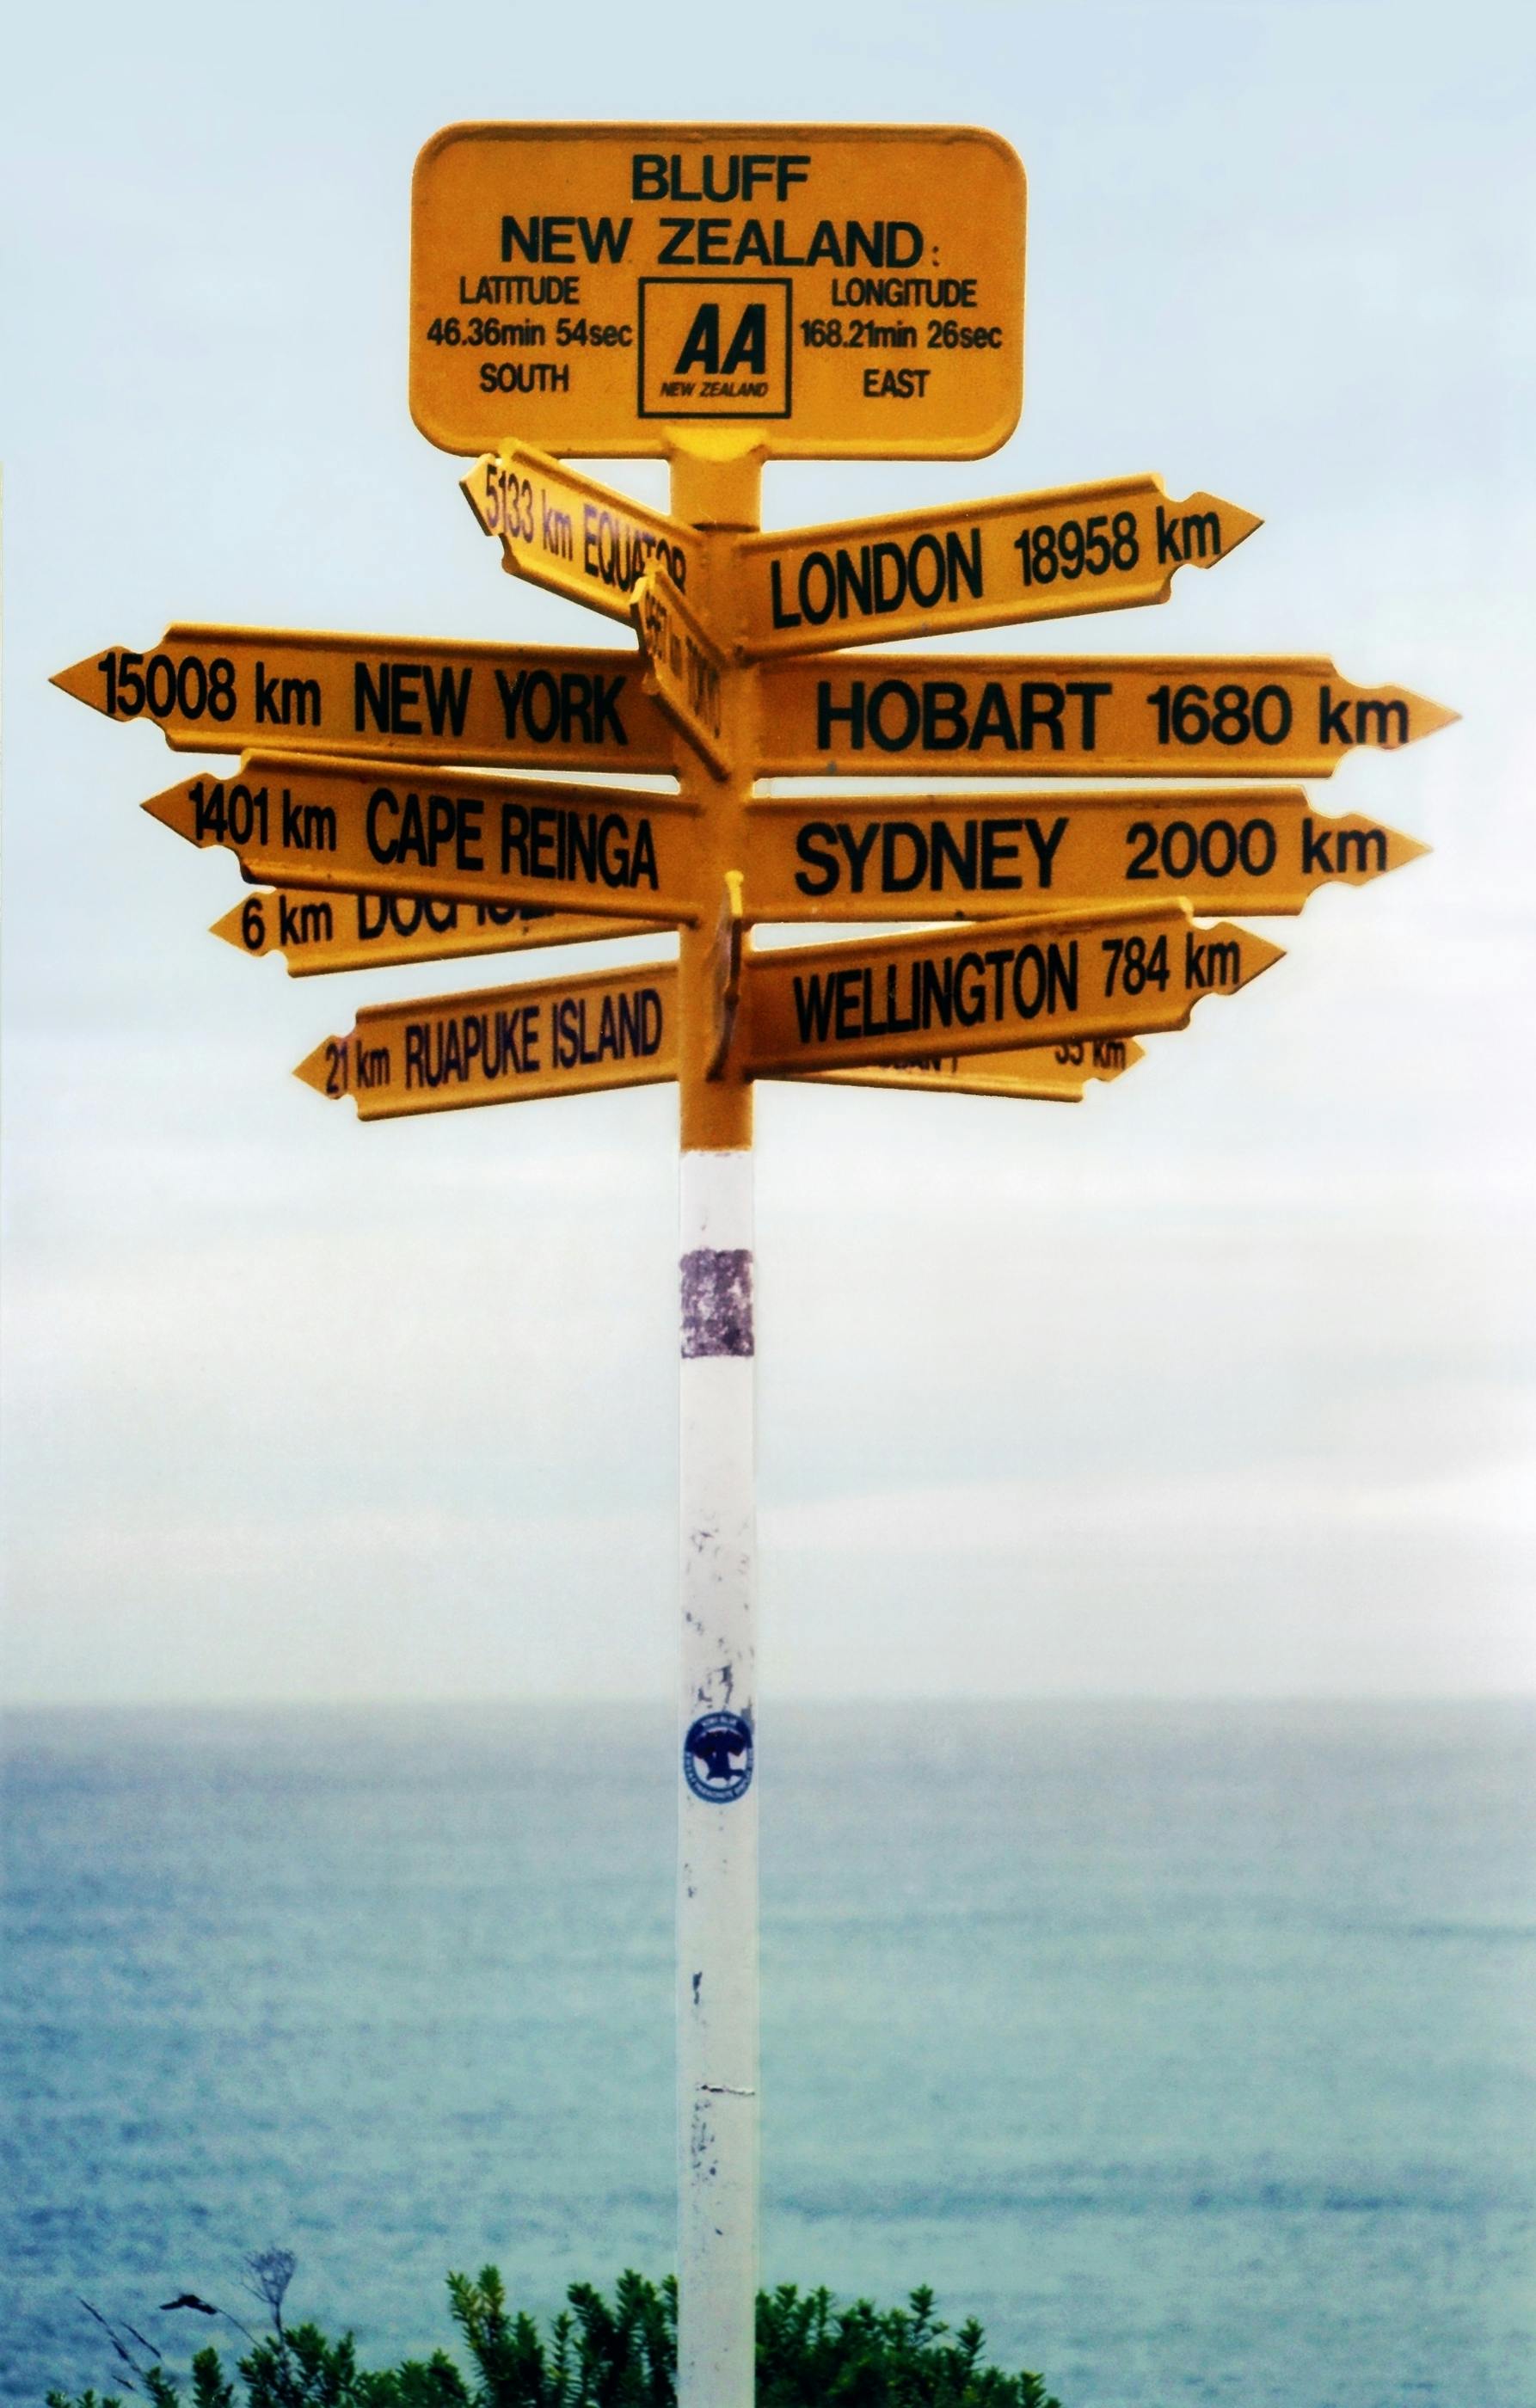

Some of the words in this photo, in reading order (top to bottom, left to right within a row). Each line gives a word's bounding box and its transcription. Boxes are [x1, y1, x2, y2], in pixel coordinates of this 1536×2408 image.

[632, 154, 810, 203] BLUFF
[501, 216, 633, 263] NEW
[459, 276, 580, 304] LATITUDE
[832, 278, 977, 307] LONGITUDE
[427, 316, 545, 347] 46.36min
[556, 317, 632, 347] 54sec
[674, 304, 766, 374] AA
[800, 319, 917, 347] 168.21min
[927, 320, 1003, 348] 26sec
[479, 362, 569, 392] SOUTH
[660, 382, 695, 396] NEW
[699, 382, 769, 397] ZEALAND
[863, 368, 931, 398] EAST
[485, 464, 533, 544] 5133
[541, 488, 573, 562] km
[770, 527, 983, 631] LONDON
[1014, 512, 1140, 587] 18958
[1157, 506, 1222, 566] km
[98, 654, 237, 722] 15008
[255, 662, 322, 727] km
[353, 662, 473, 738] NEW
[495, 669, 629, 746] YORK
[816, 681, 1113, 752] HOBART
[1147, 685, 1292, 746] 1680
[1319, 688, 1410, 745] km
[189, 783, 270, 847] 1401
[282, 789, 337, 852] km
[366, 788, 484, 871] CAPE
[501, 804, 660, 890] REINGA
[794, 816, 1070, 896] SYDNEY
[1125, 819, 1275, 881] 2000
[1302, 819, 1388, 873] km
[242, 897, 265, 950] 6
[279, 894, 333, 946] km
[793, 941, 1078, 1044] WELLINGTON
[1102, 936, 1170, 998] 784
[1185, 931, 1241, 989] km
[325, 1041, 348, 1094] 21
[356, 1040, 390, 1090] km
[405, 1004, 541, 1090] RUAPUKE
[551, 988, 662, 1069] ISLAND
